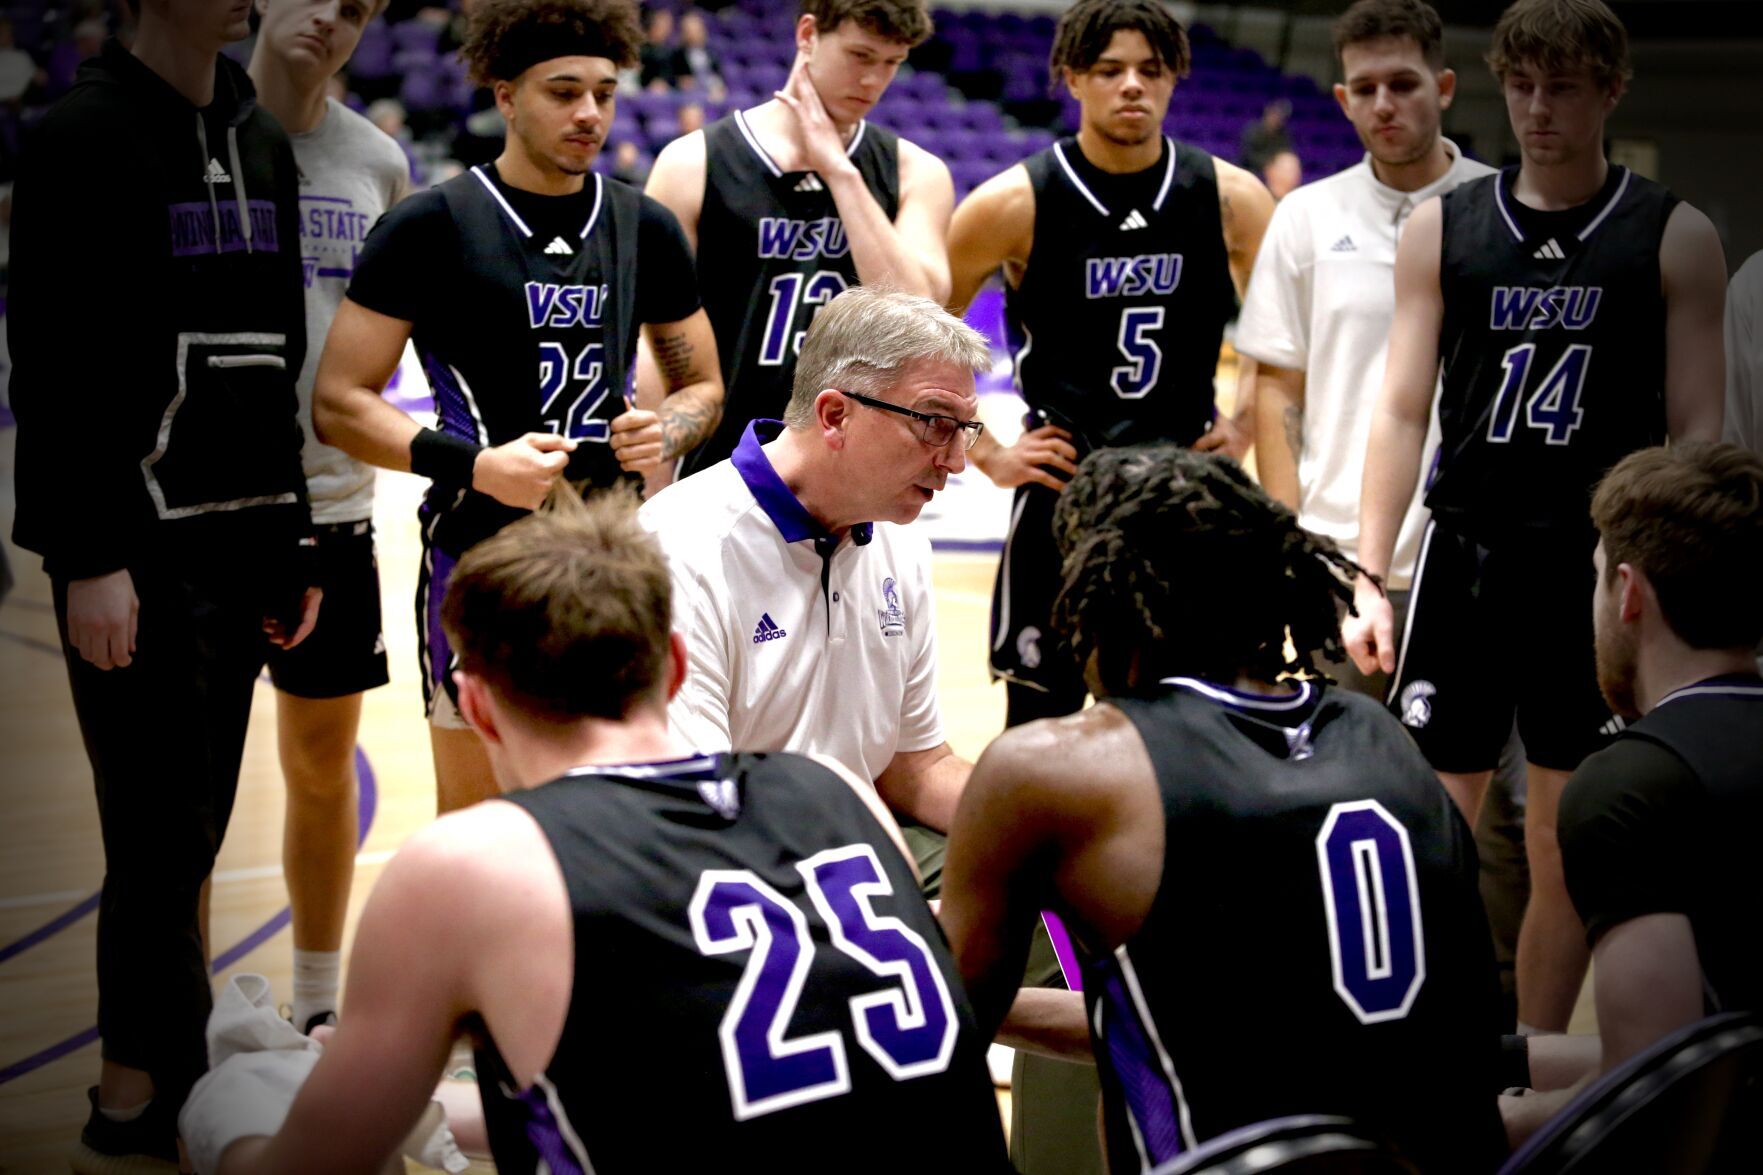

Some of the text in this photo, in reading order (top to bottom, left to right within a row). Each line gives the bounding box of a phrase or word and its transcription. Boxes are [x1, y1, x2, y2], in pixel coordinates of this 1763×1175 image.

[309, 207, 369, 242] STATE
[757, 217, 850, 260] WSU
[1086, 253, 1184, 299] WSU
[1490, 286, 1603, 330] WSU
[1110, 306, 1165, 399] 5
[538, 341, 611, 443] 22
[1486, 343, 1593, 446] 14
[753, 628, 787, 644] adidas
[1315, 798, 1426, 1025] 0
[688, 843, 959, 1122] 25
